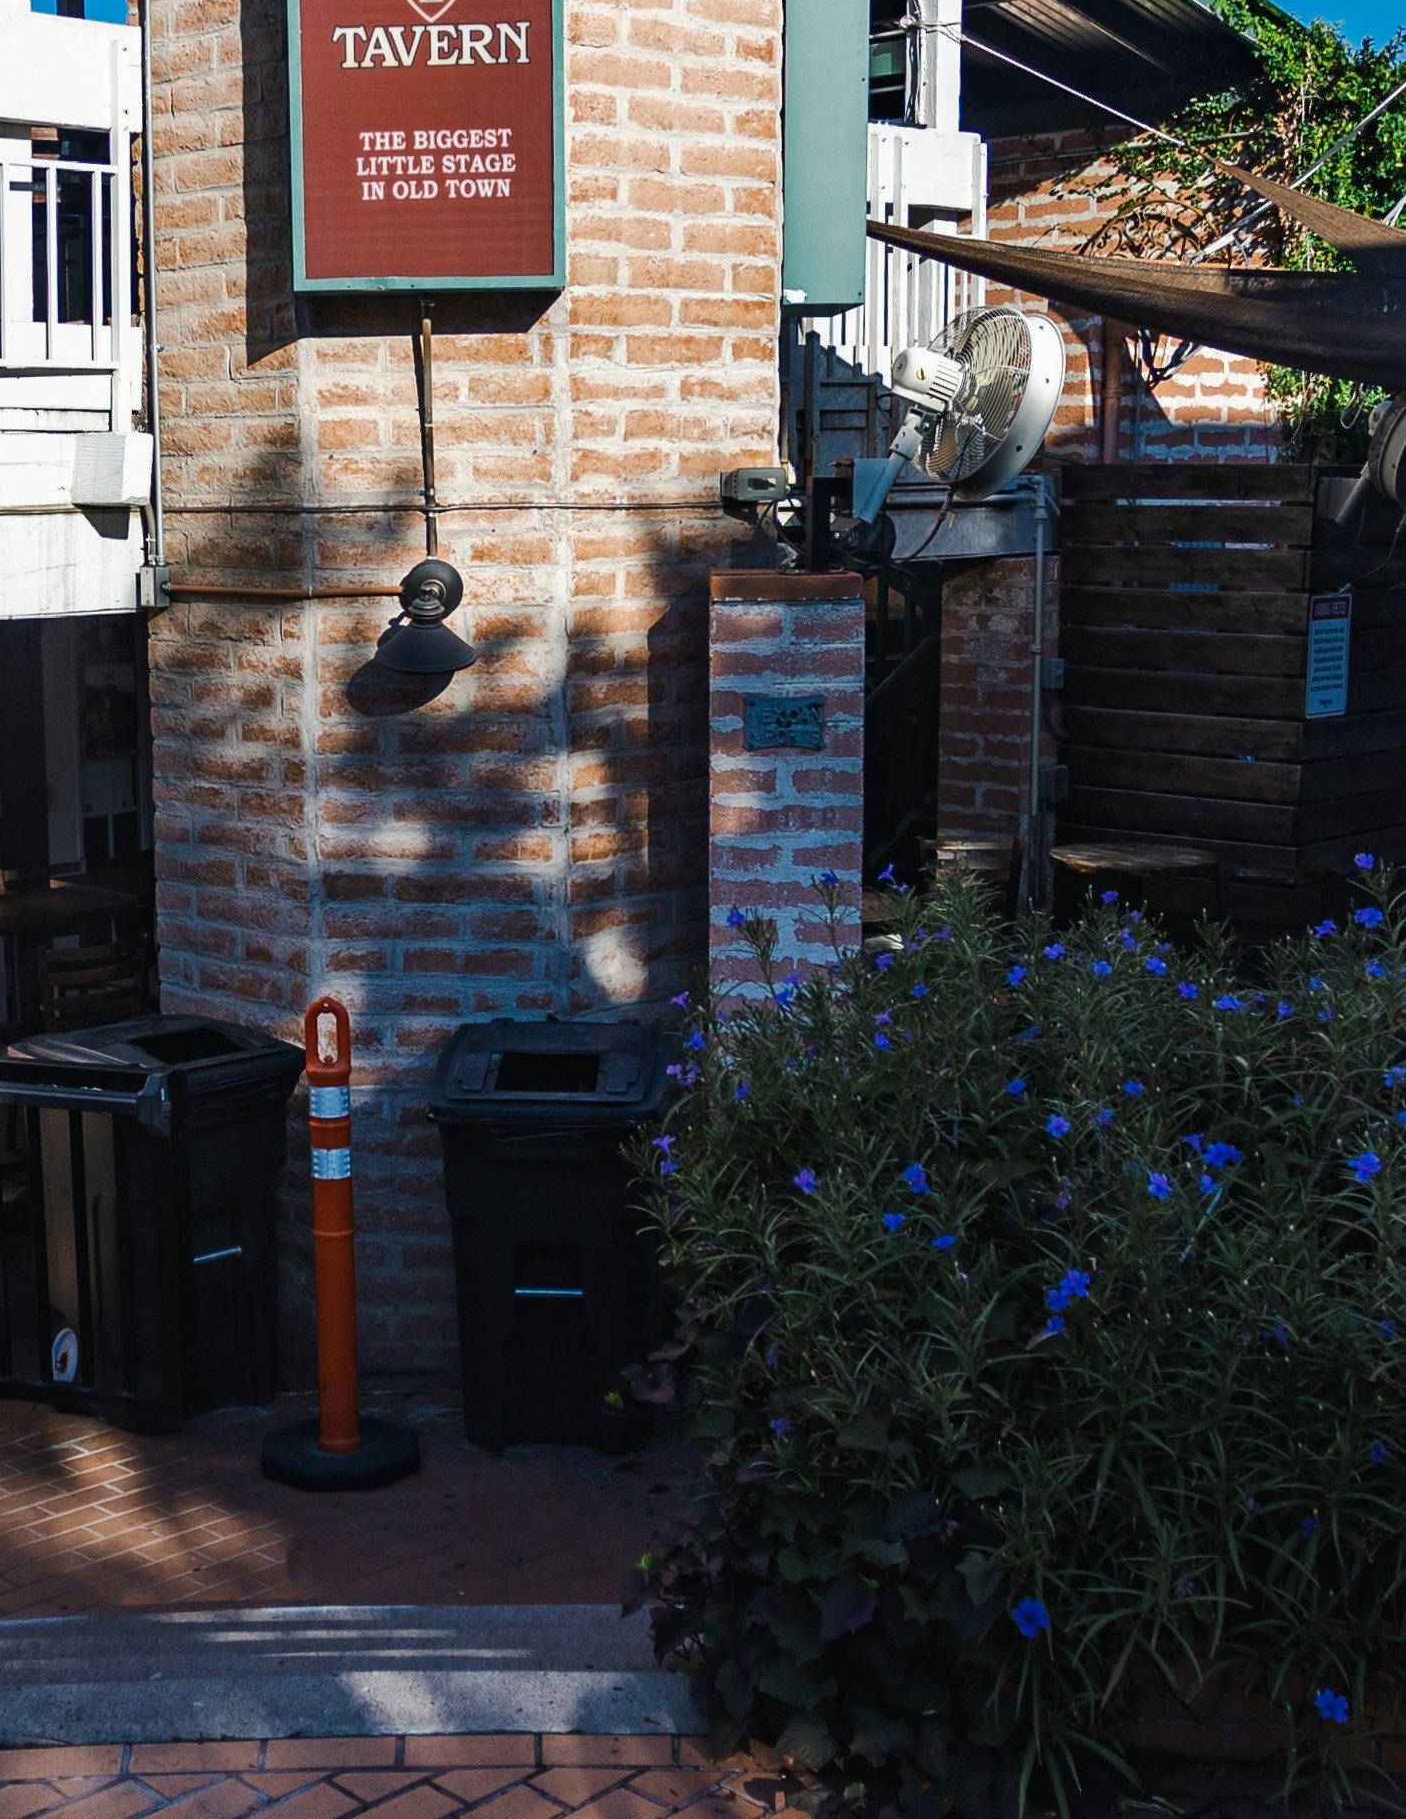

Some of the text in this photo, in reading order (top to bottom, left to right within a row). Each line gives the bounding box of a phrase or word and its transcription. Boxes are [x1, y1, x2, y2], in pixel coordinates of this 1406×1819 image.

[331, 21, 531, 69] TAVERN
[359, 128, 512, 152] THE BIGGEST
[355, 153, 516, 177] LITTLE STAGE
[361, 178, 512, 202] IN OLD TOWN
[747, 728, 822, 745] MPORTS
